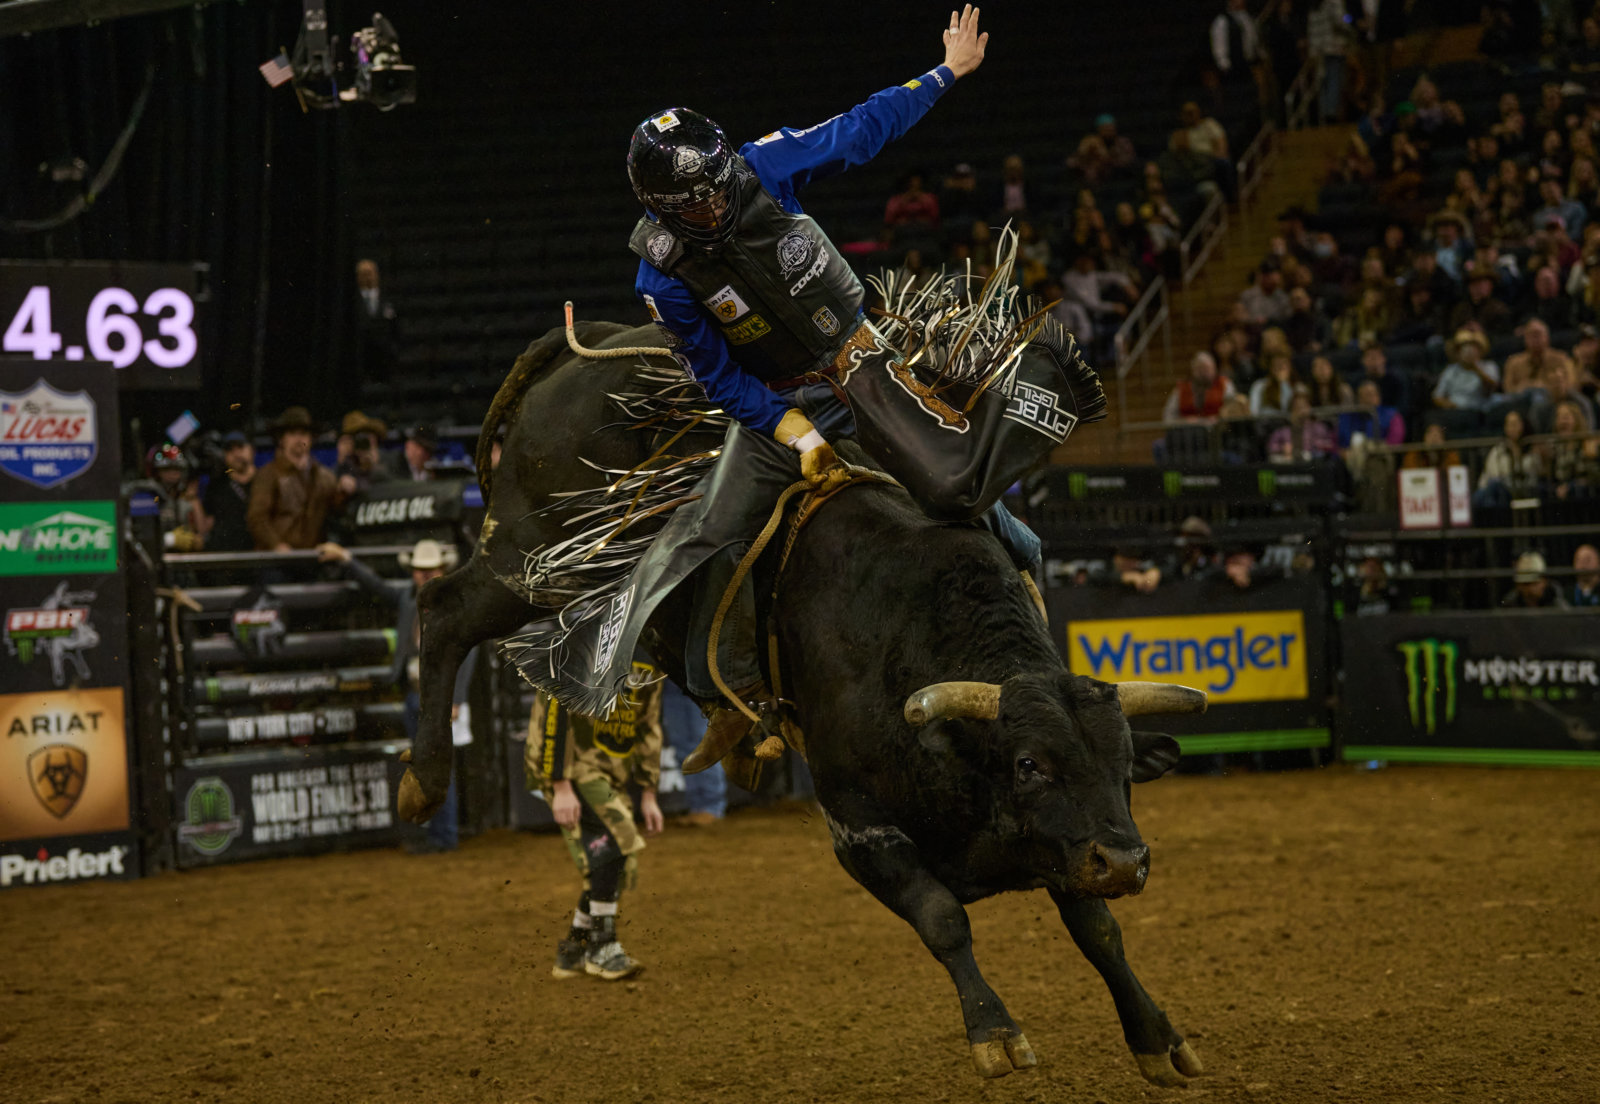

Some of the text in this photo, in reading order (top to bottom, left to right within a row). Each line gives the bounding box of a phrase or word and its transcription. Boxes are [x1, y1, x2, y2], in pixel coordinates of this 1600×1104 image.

[3, 285, 198, 369] 4.63
[3, 416, 87, 442] LUCAS
[1038, 410, 1071, 435] PIT
[0, 445, 91, 461] OIL PRODUCTS
[356, 495, 436, 526] LUCAS OIL
[11, 610, 83, 630] PBR
[1077, 627, 1297, 693] Wrangler
[1464, 656, 1599, 686] MONSTER
[8, 712, 103, 738] ARIAT
[0, 849, 124, 885] Priefert
